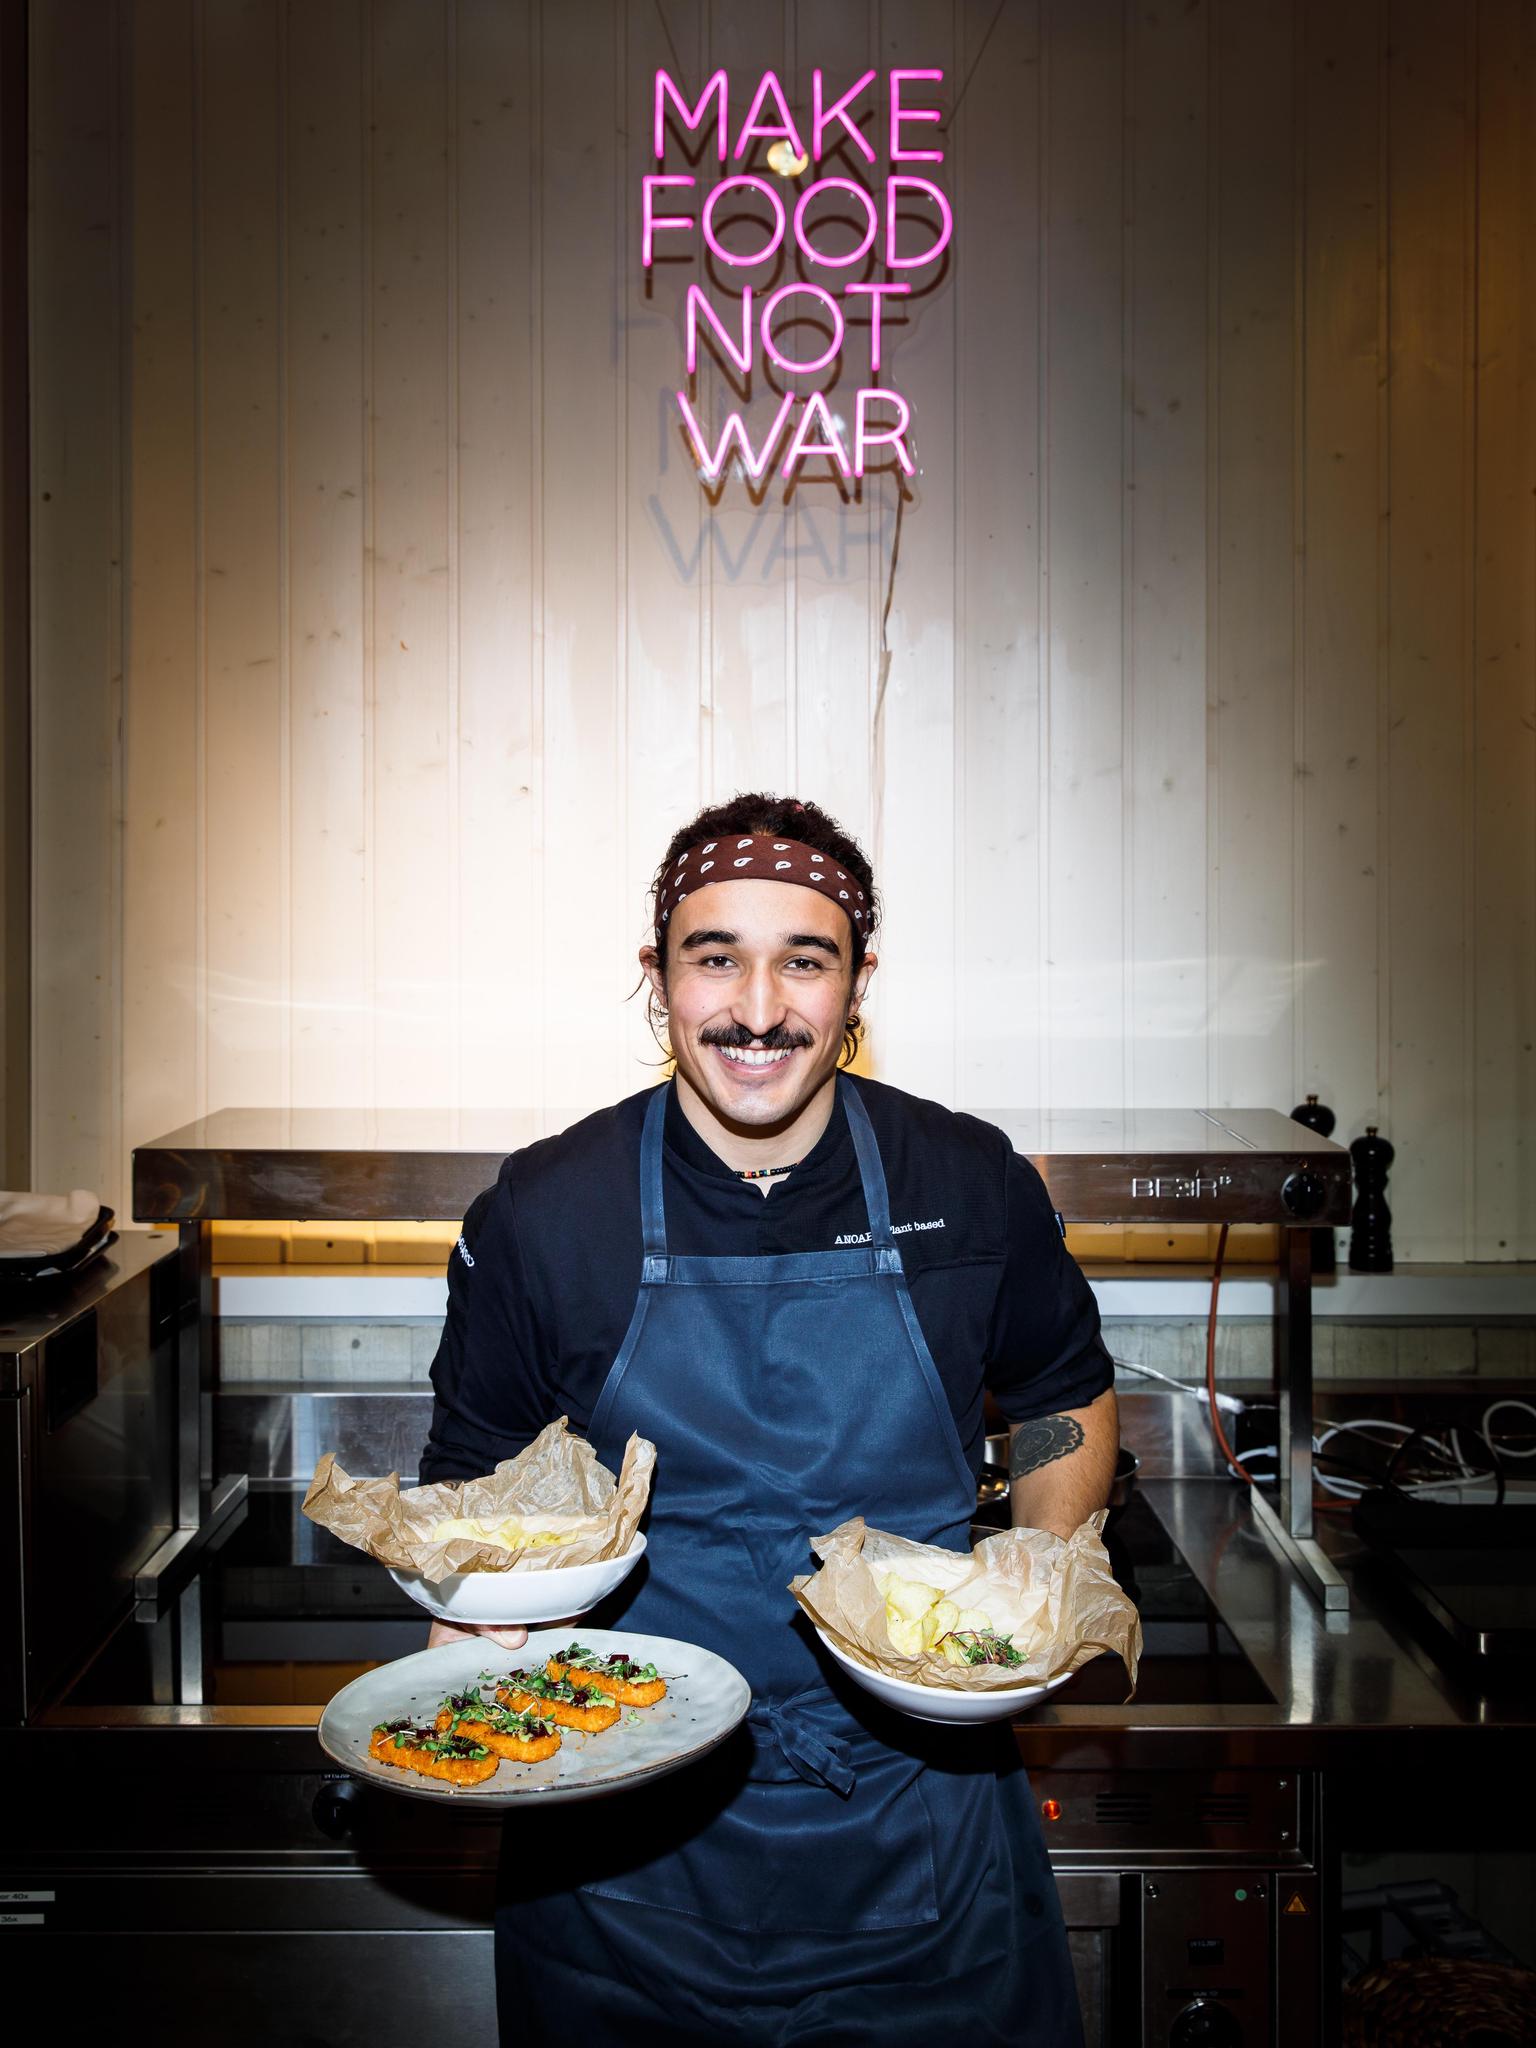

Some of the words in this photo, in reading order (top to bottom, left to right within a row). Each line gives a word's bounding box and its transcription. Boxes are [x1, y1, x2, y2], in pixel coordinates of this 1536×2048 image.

[653, 68, 944, 163] MAKE
[642, 174, 954, 269] FOOD
[685, 282, 912, 374] NOT
[676, 388, 916, 480] WAR
[889, 1222, 913, 1235] lant
[914, 1218, 946, 1231] based
